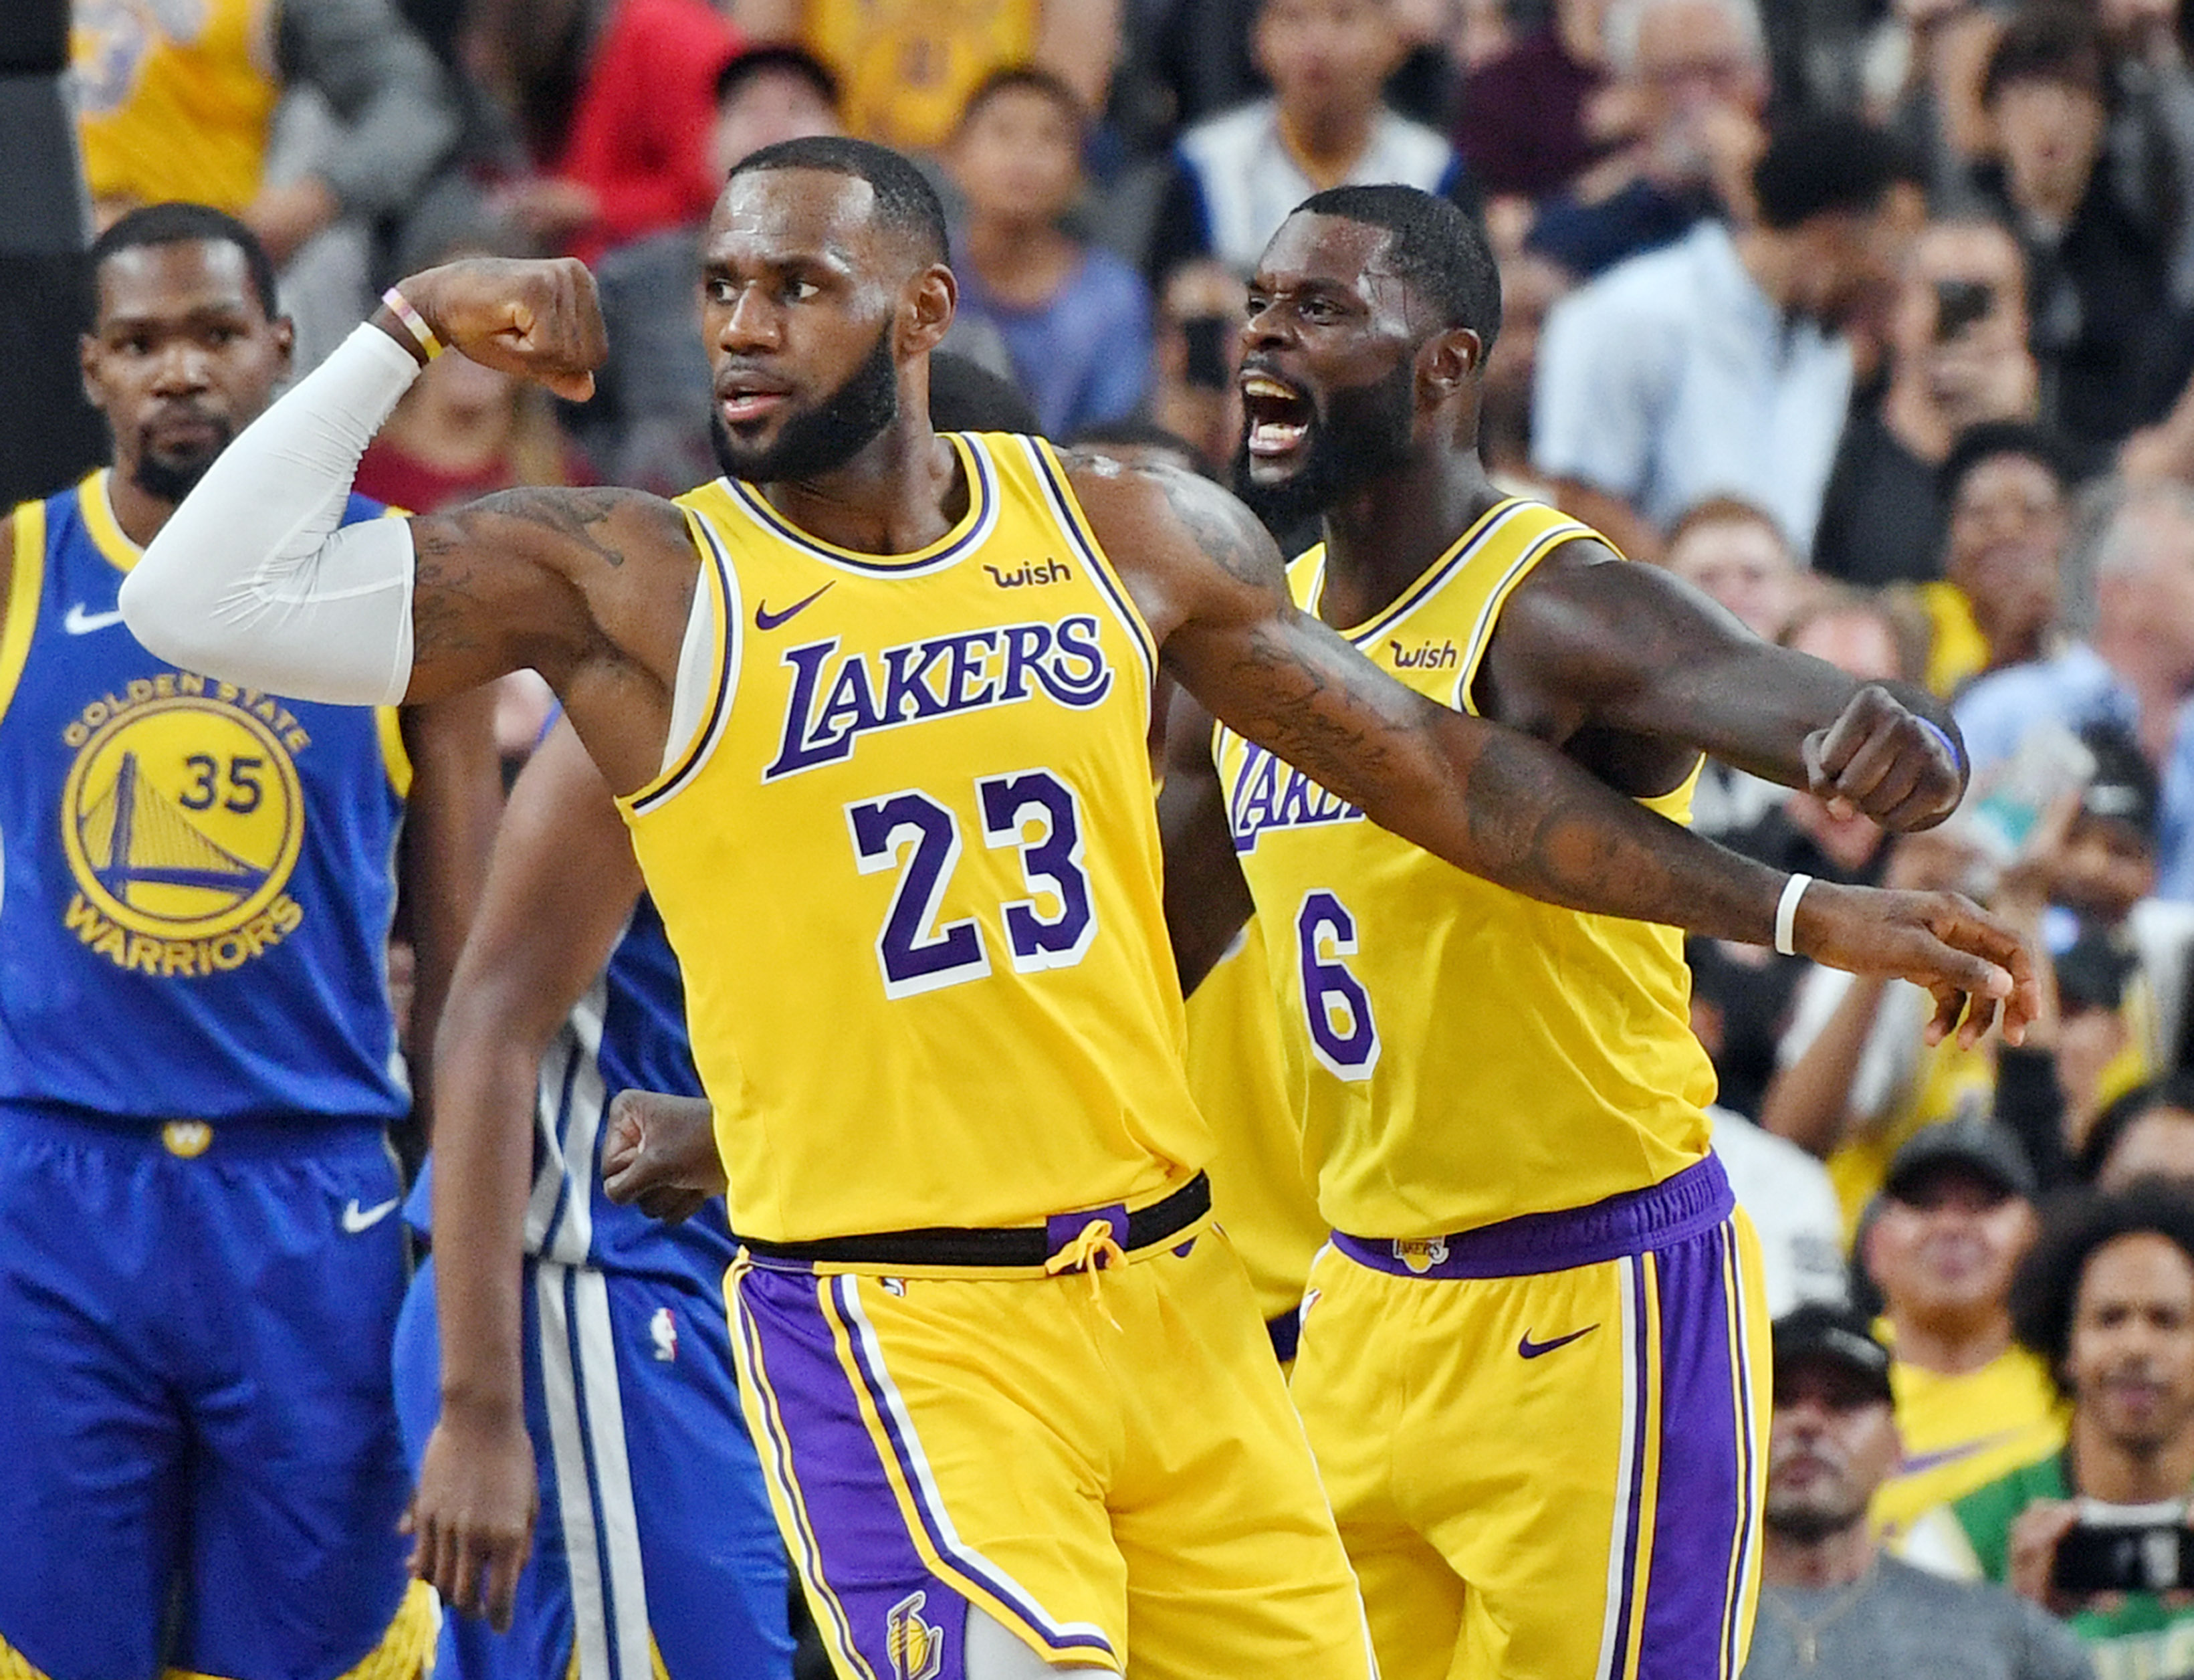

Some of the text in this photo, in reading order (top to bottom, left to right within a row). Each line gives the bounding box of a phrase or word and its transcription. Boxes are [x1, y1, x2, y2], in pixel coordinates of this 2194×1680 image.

[983, 558, 1071, 589] wish
[1390, 640, 1456, 668] wish
[762, 615, 1114, 784] LAKERS
[180, 755, 263, 814] 35
[844, 767, 1099, 1000] 23
[65, 894, 303, 976] WARRIORS
[1295, 889, 1381, 1081] 6
